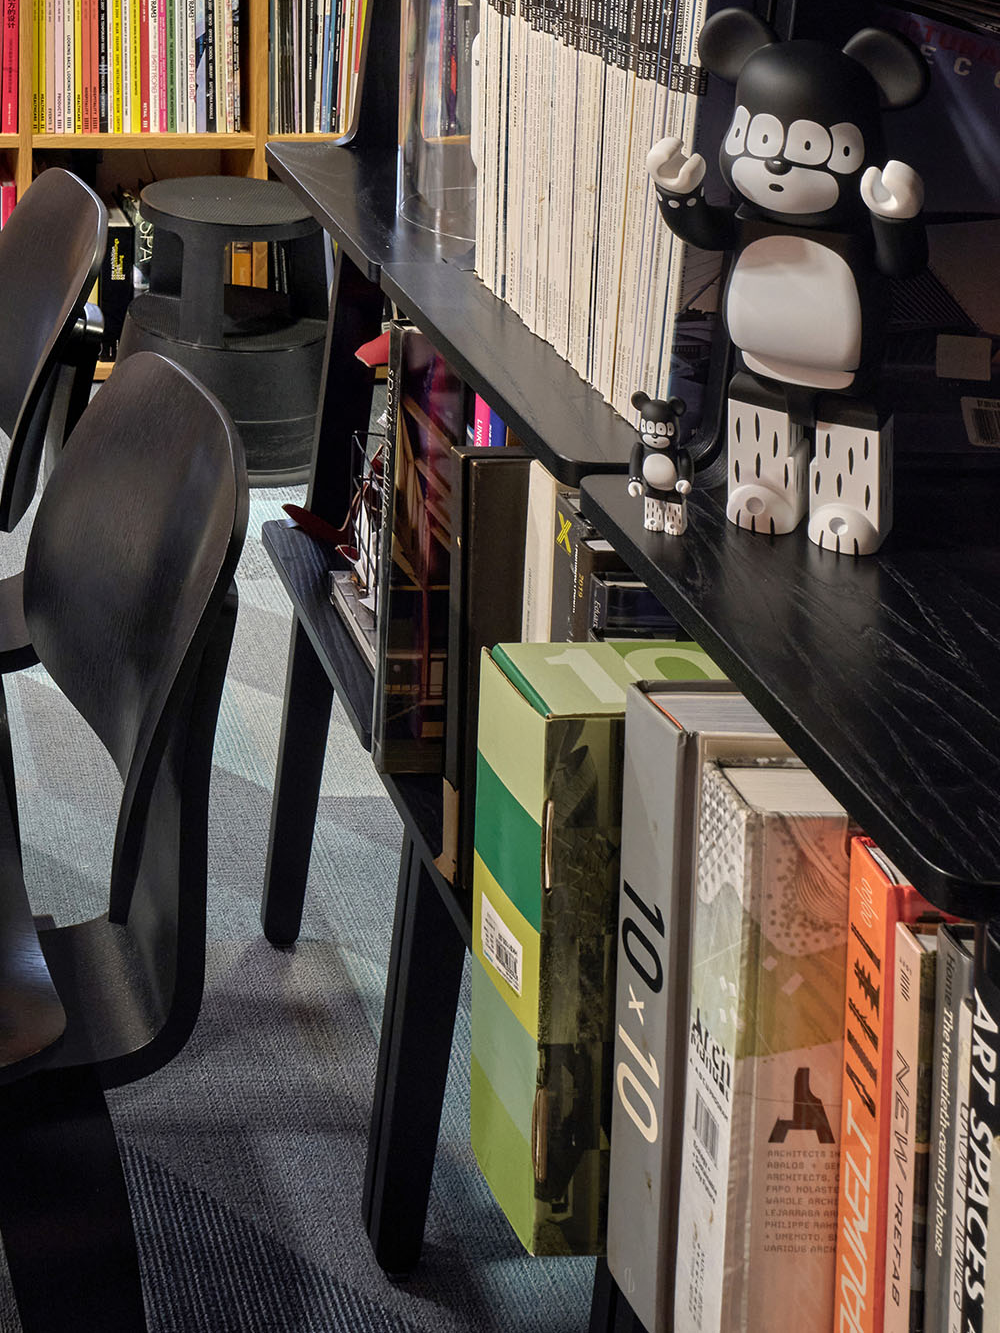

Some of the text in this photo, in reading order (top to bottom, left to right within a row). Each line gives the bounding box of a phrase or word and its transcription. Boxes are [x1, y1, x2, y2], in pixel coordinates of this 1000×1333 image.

[138, 221, 154, 263] SPA
[386, 368, 394, 431] sports
[943, 952, 956, 1007] Home
[616, 880, 665, 1144] 10 x 10
[888, 1049, 911, 1308] NEW PREFAB
[963, 987, 999, 1309] ART SPACES
[934, 1198, 946, 1257] house
